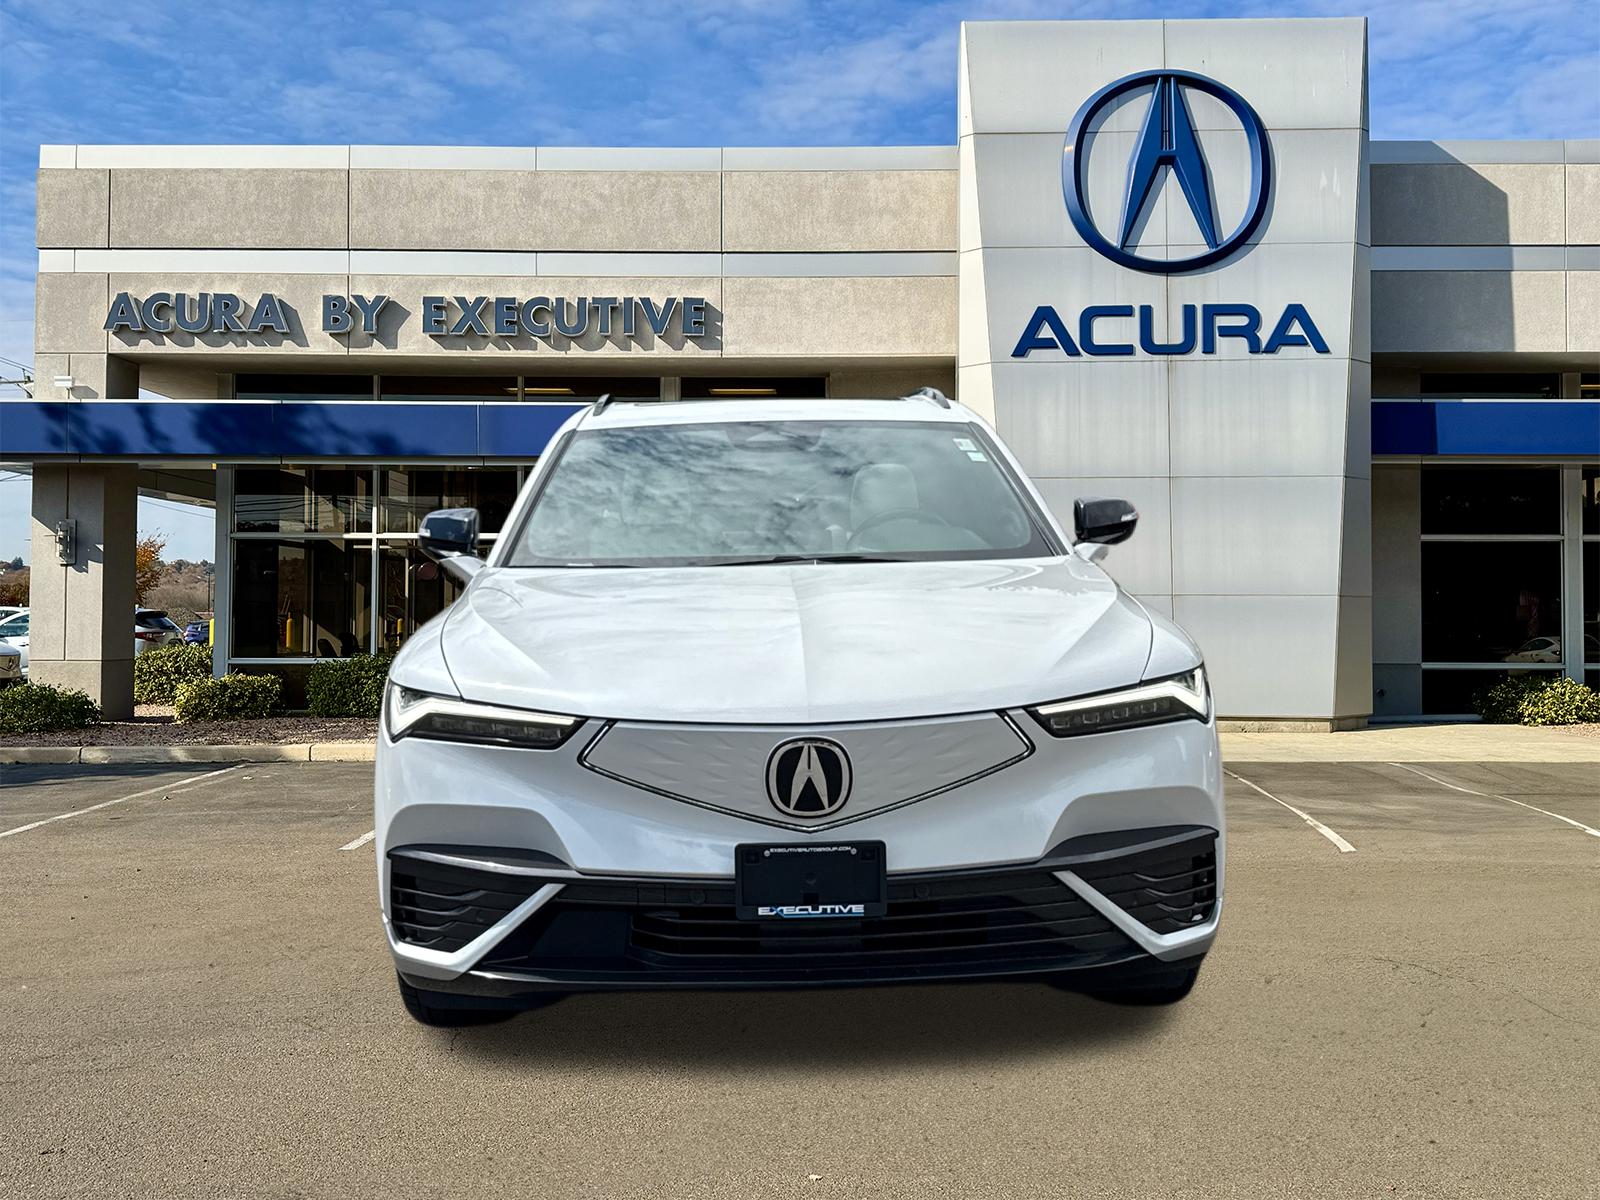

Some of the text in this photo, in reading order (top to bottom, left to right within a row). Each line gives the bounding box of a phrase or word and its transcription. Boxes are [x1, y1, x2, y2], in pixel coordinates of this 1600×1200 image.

[104, 292, 708, 338] ACURA BY EXECUTIVE
[1011, 303, 1331, 357] ACURA
[758, 904, 865, 917] EXECUTIVE
